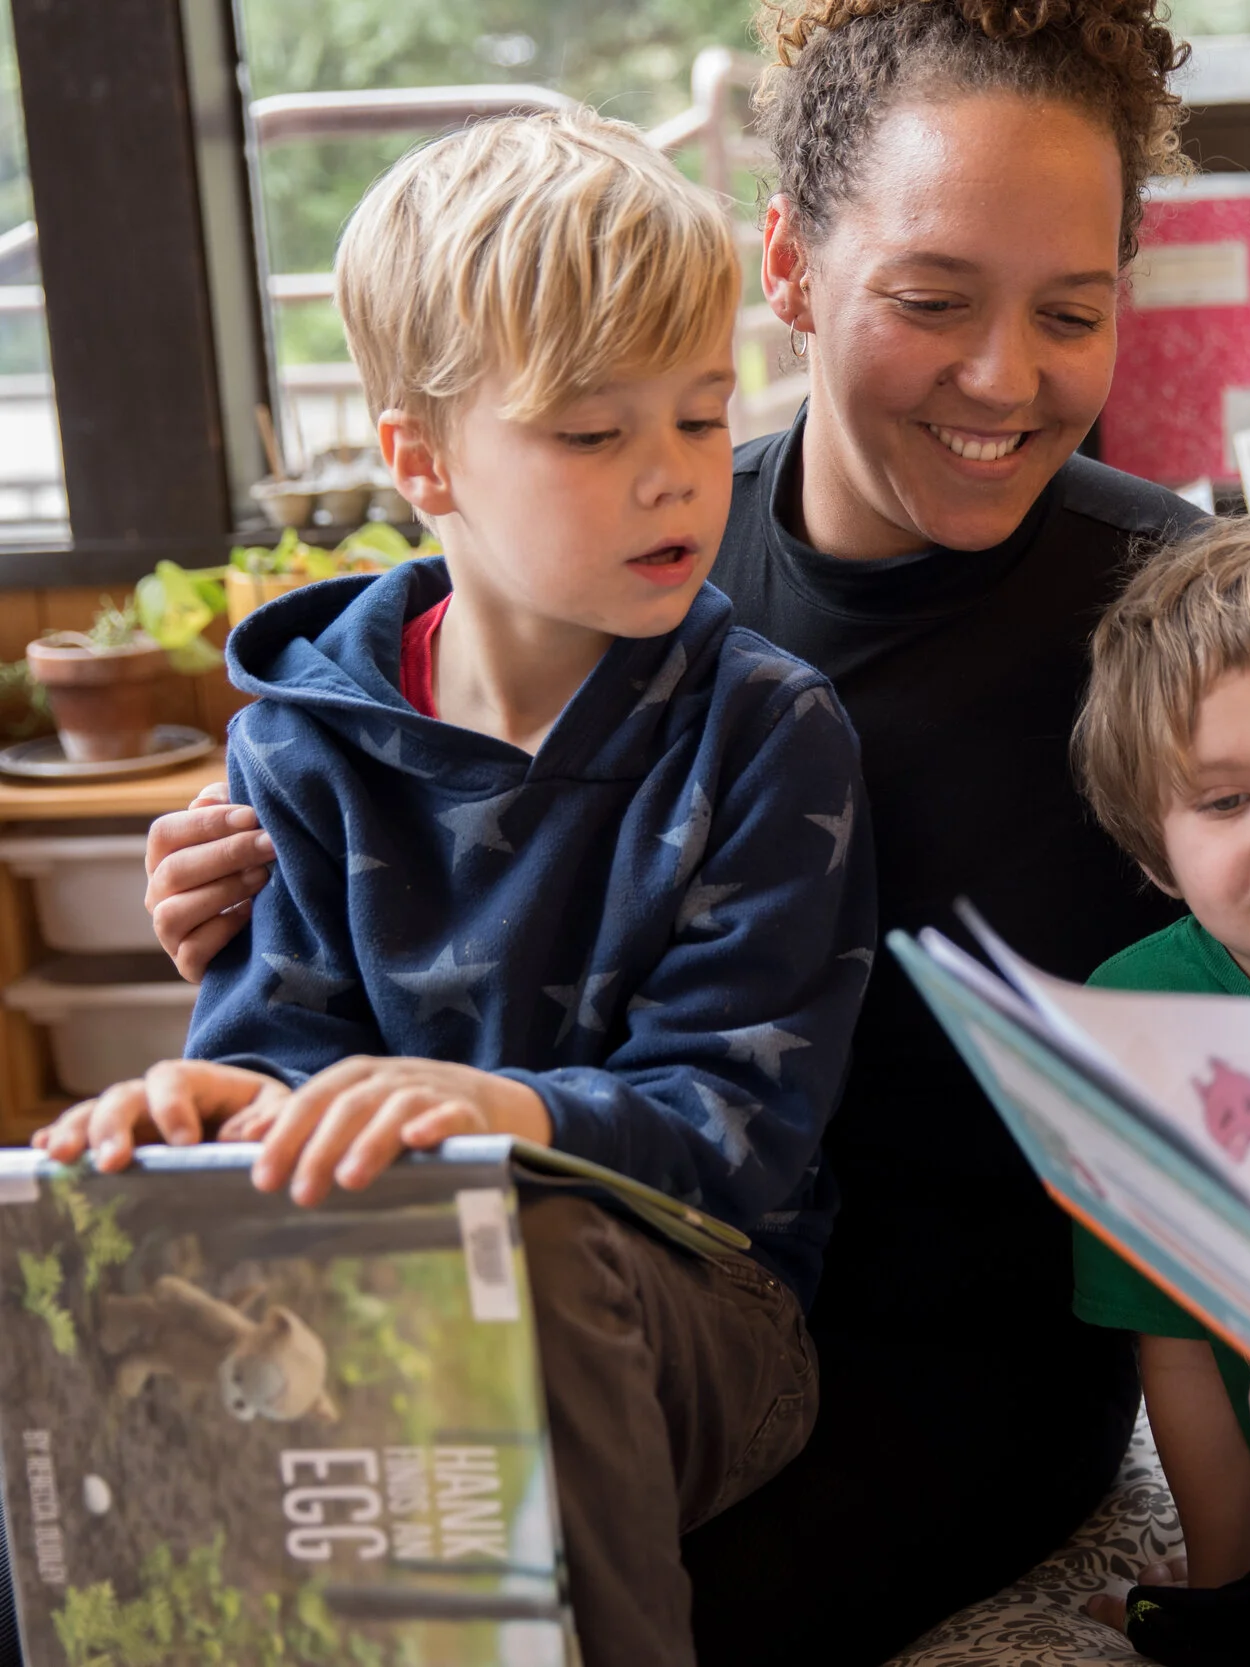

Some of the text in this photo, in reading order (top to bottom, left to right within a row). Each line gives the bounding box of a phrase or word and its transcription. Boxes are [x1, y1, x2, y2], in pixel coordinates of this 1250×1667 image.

[281, 1449, 388, 1561] EGG
[384, 1446, 435, 1560] FINDS AN
[433, 1446, 508, 1560] HANK
